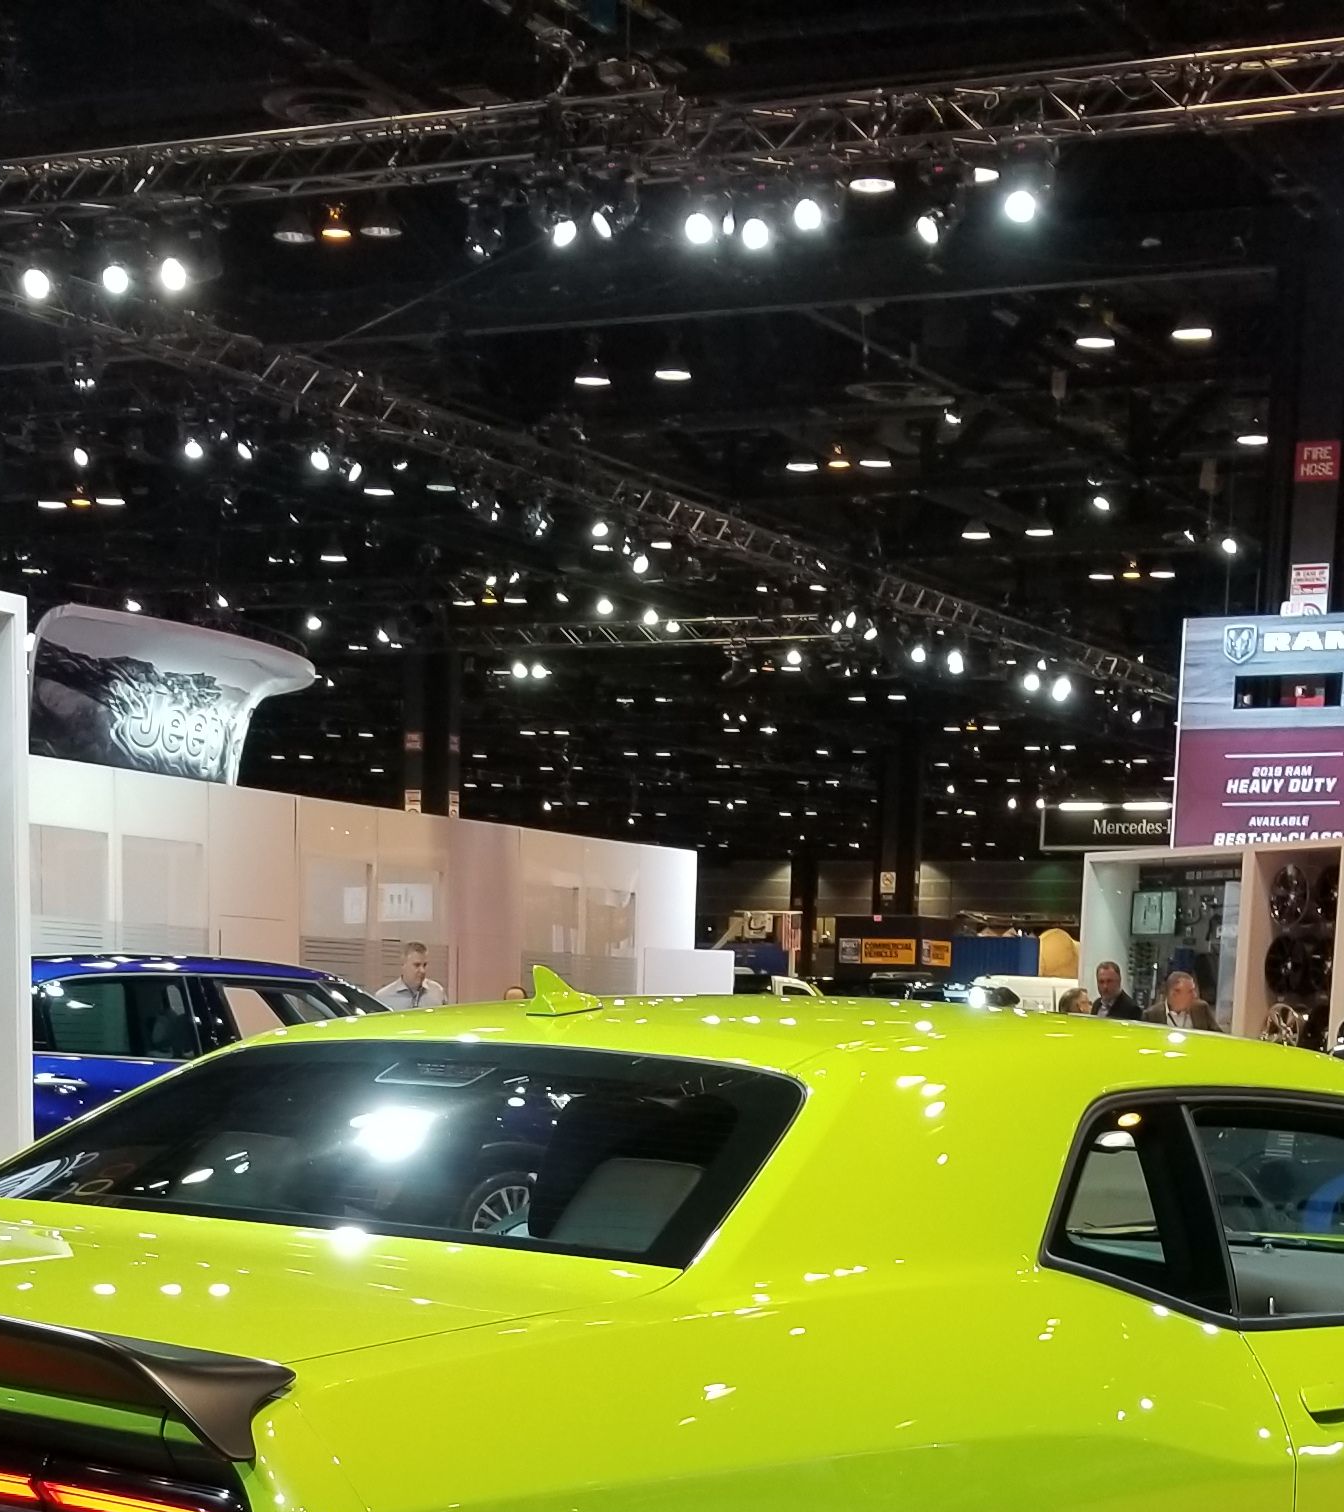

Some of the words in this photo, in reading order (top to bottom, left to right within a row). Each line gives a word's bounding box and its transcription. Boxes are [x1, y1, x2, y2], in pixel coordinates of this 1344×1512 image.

[1303, 446, 1333, 461] FIRE
[1299, 462, 1334, 477] HOSE
[128, 690, 226, 772] Jeep
[1285, 765, 1313, 777] RAM
[1225, 778, 1285, 794] HEAVY
[1288, 777, 1338, 793] DUTY
[1248, 815, 1310, 827] AVAILABLE
